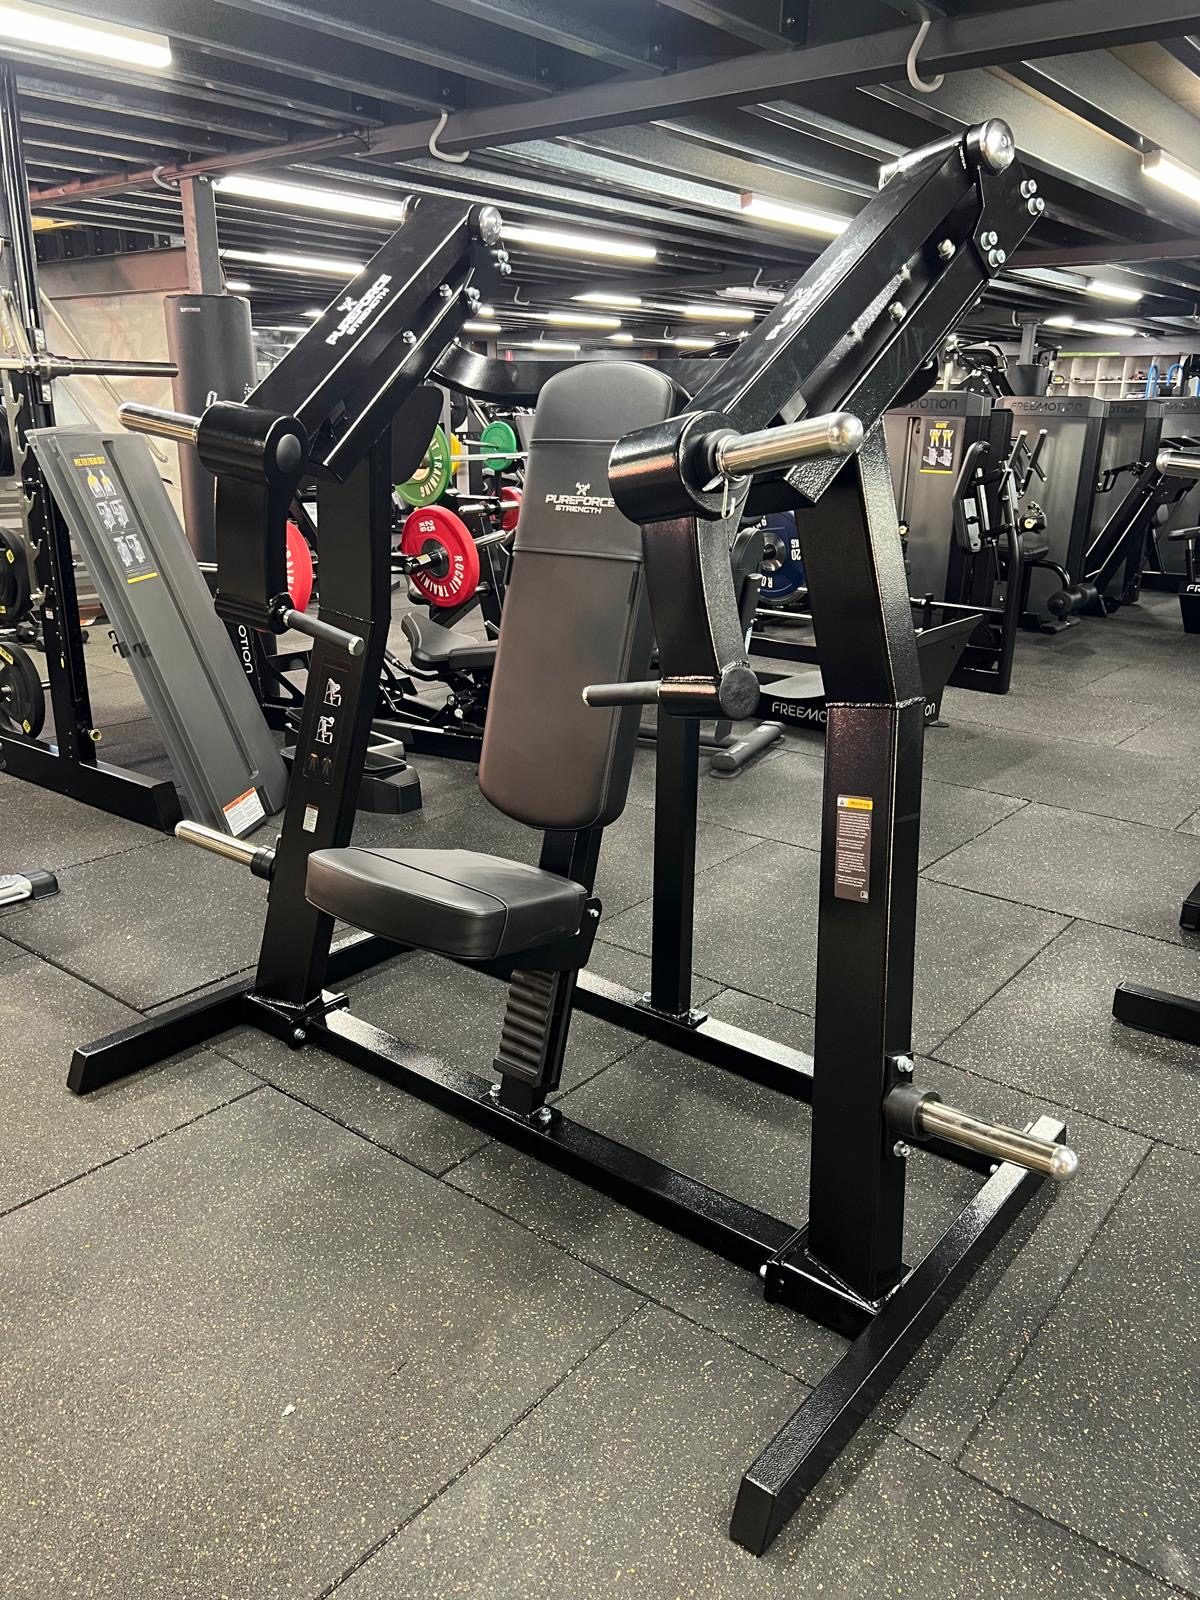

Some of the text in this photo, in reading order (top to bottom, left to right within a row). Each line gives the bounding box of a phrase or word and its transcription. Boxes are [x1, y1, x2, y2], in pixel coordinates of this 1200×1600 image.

[325, 273, 392, 346] PUREFORCE
[346, 287, 390, 335] STRENGTH
[420, 454, 443, 498] TRAINING
[545, 494, 615, 508] PUREFORCE
[554, 504, 602, 515] STRENGTH
[425, 520, 436, 532] 25
[791, 549, 801, 560] 20
[449, 555, 464, 593] ROCKIT
[238, 624, 254, 674] OTION
[771, 701, 828, 723] FREEMO
